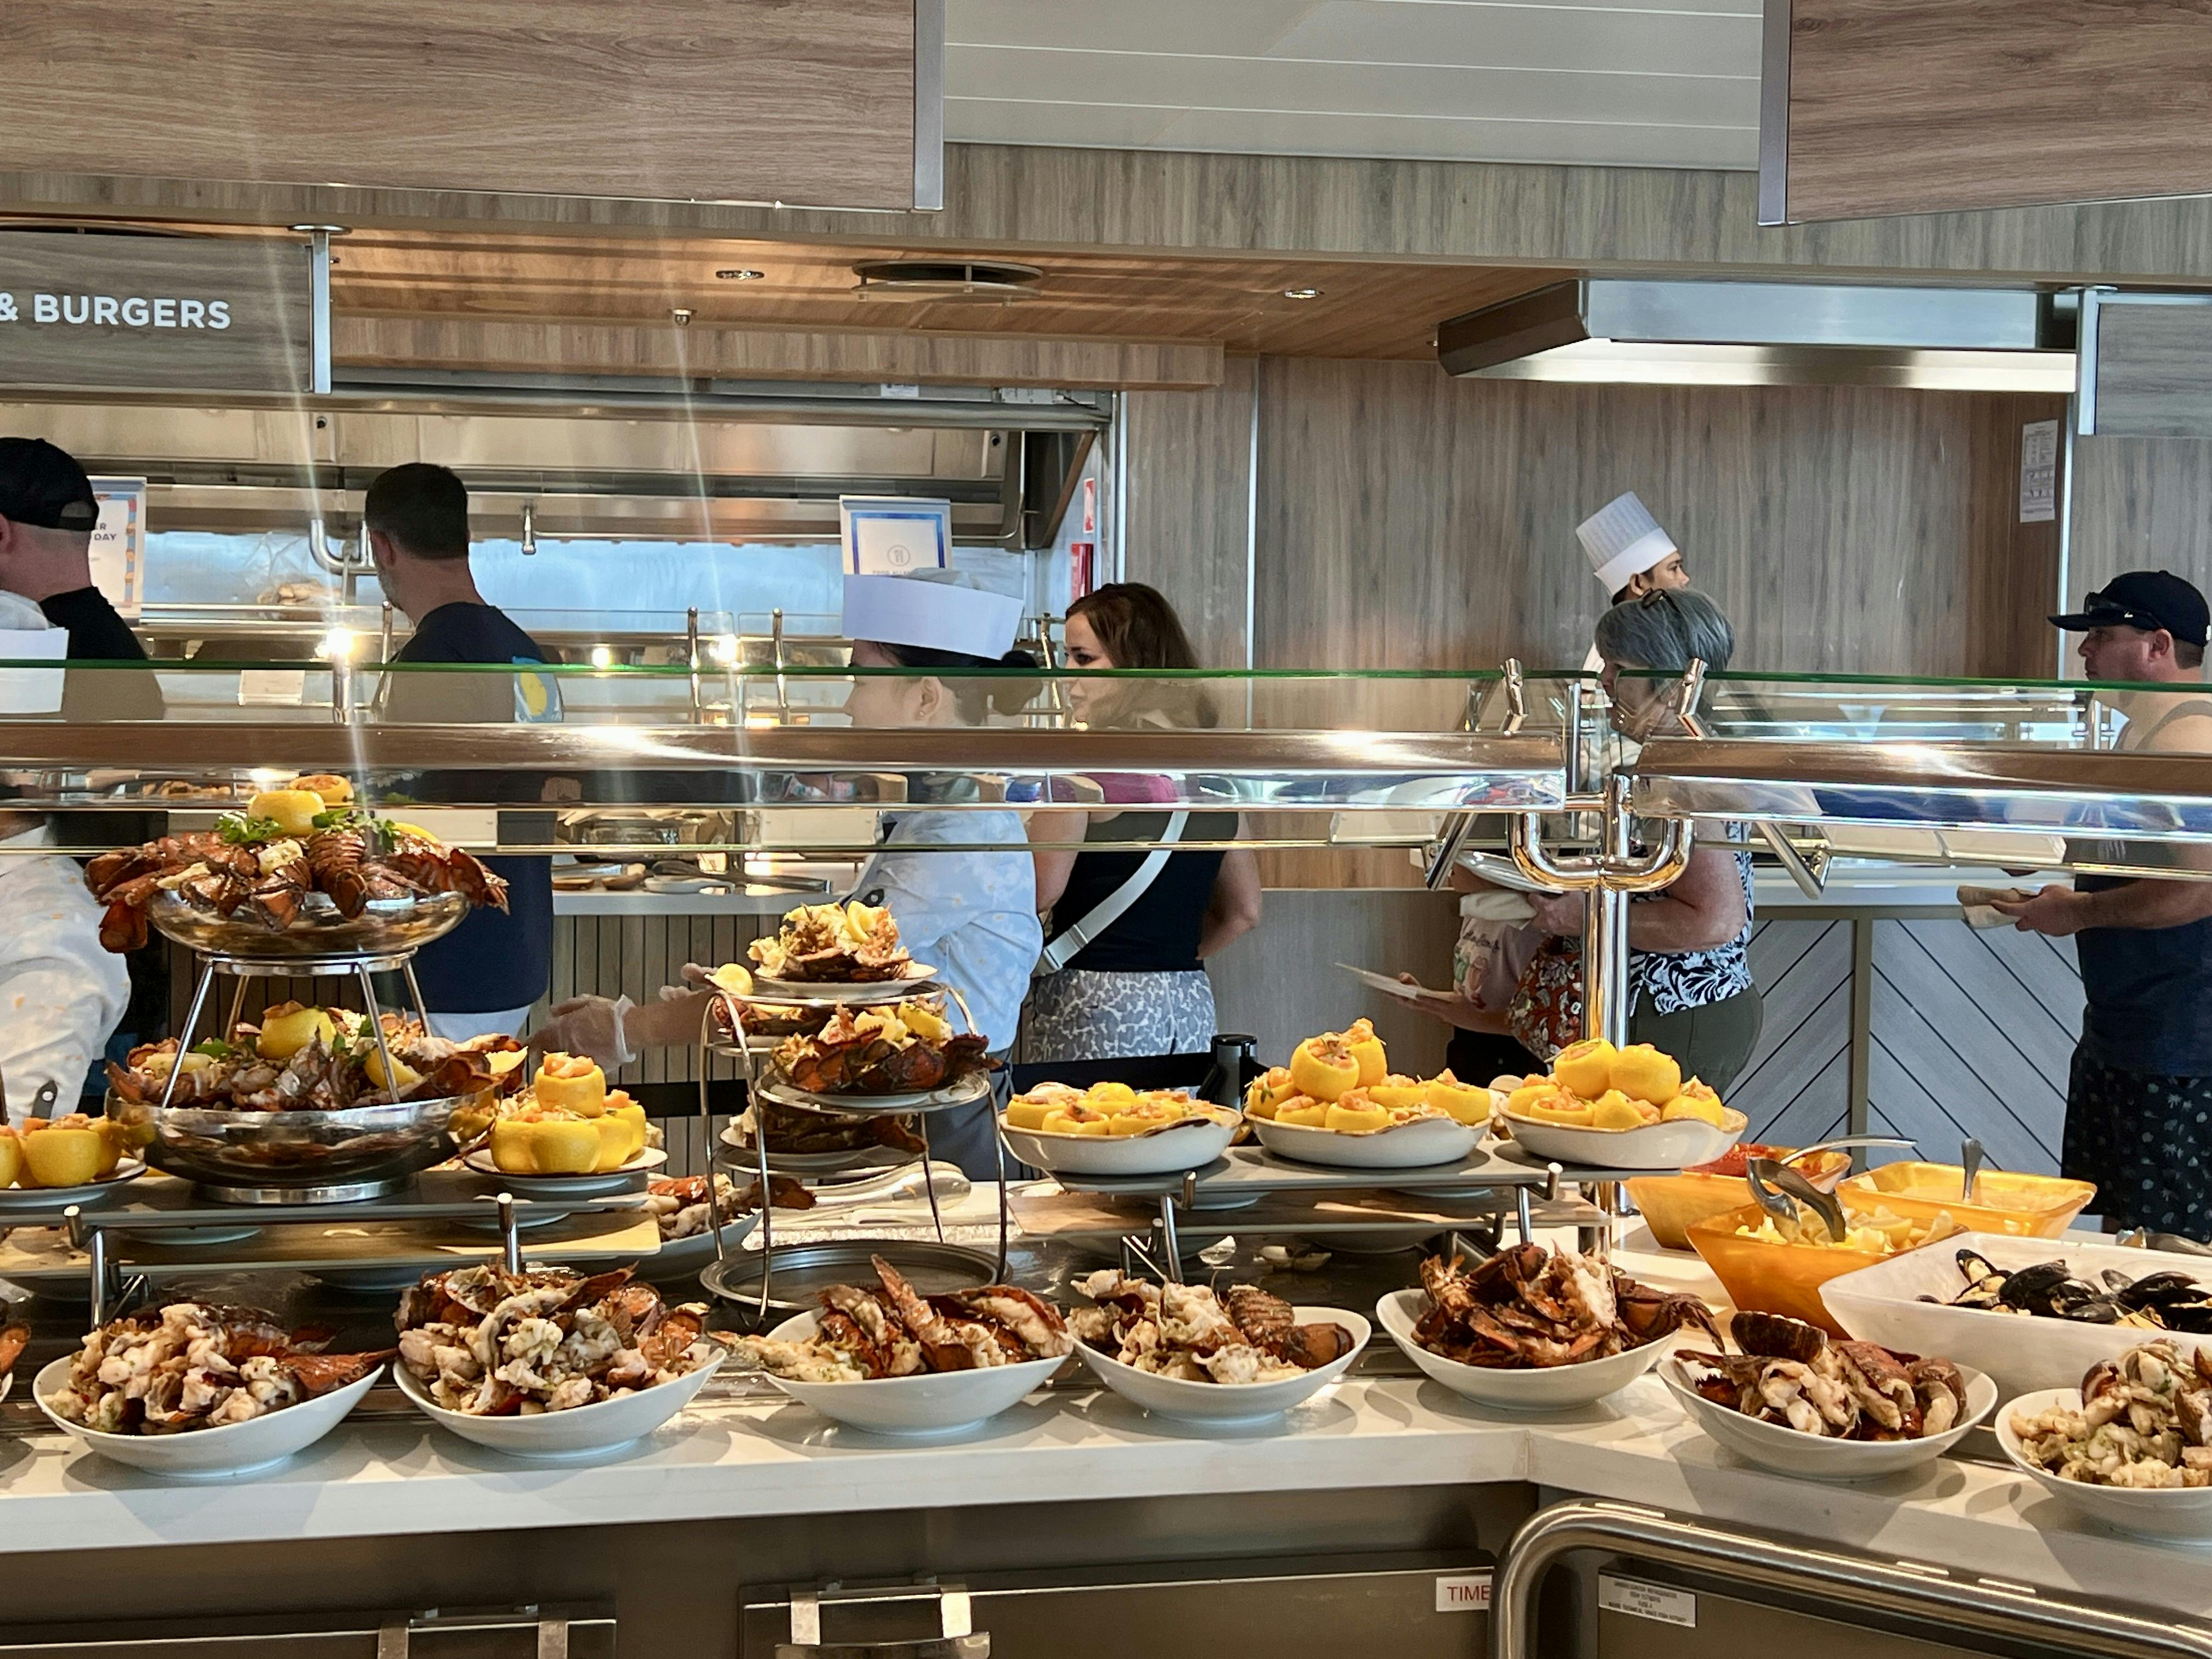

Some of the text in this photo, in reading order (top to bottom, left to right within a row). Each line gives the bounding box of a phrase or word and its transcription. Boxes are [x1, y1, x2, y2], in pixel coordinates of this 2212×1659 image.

[0, 292, 231, 329] & BURGERS
[94, 533, 117, 541] DAY
[1447, 1585, 1491, 1601] TIME
